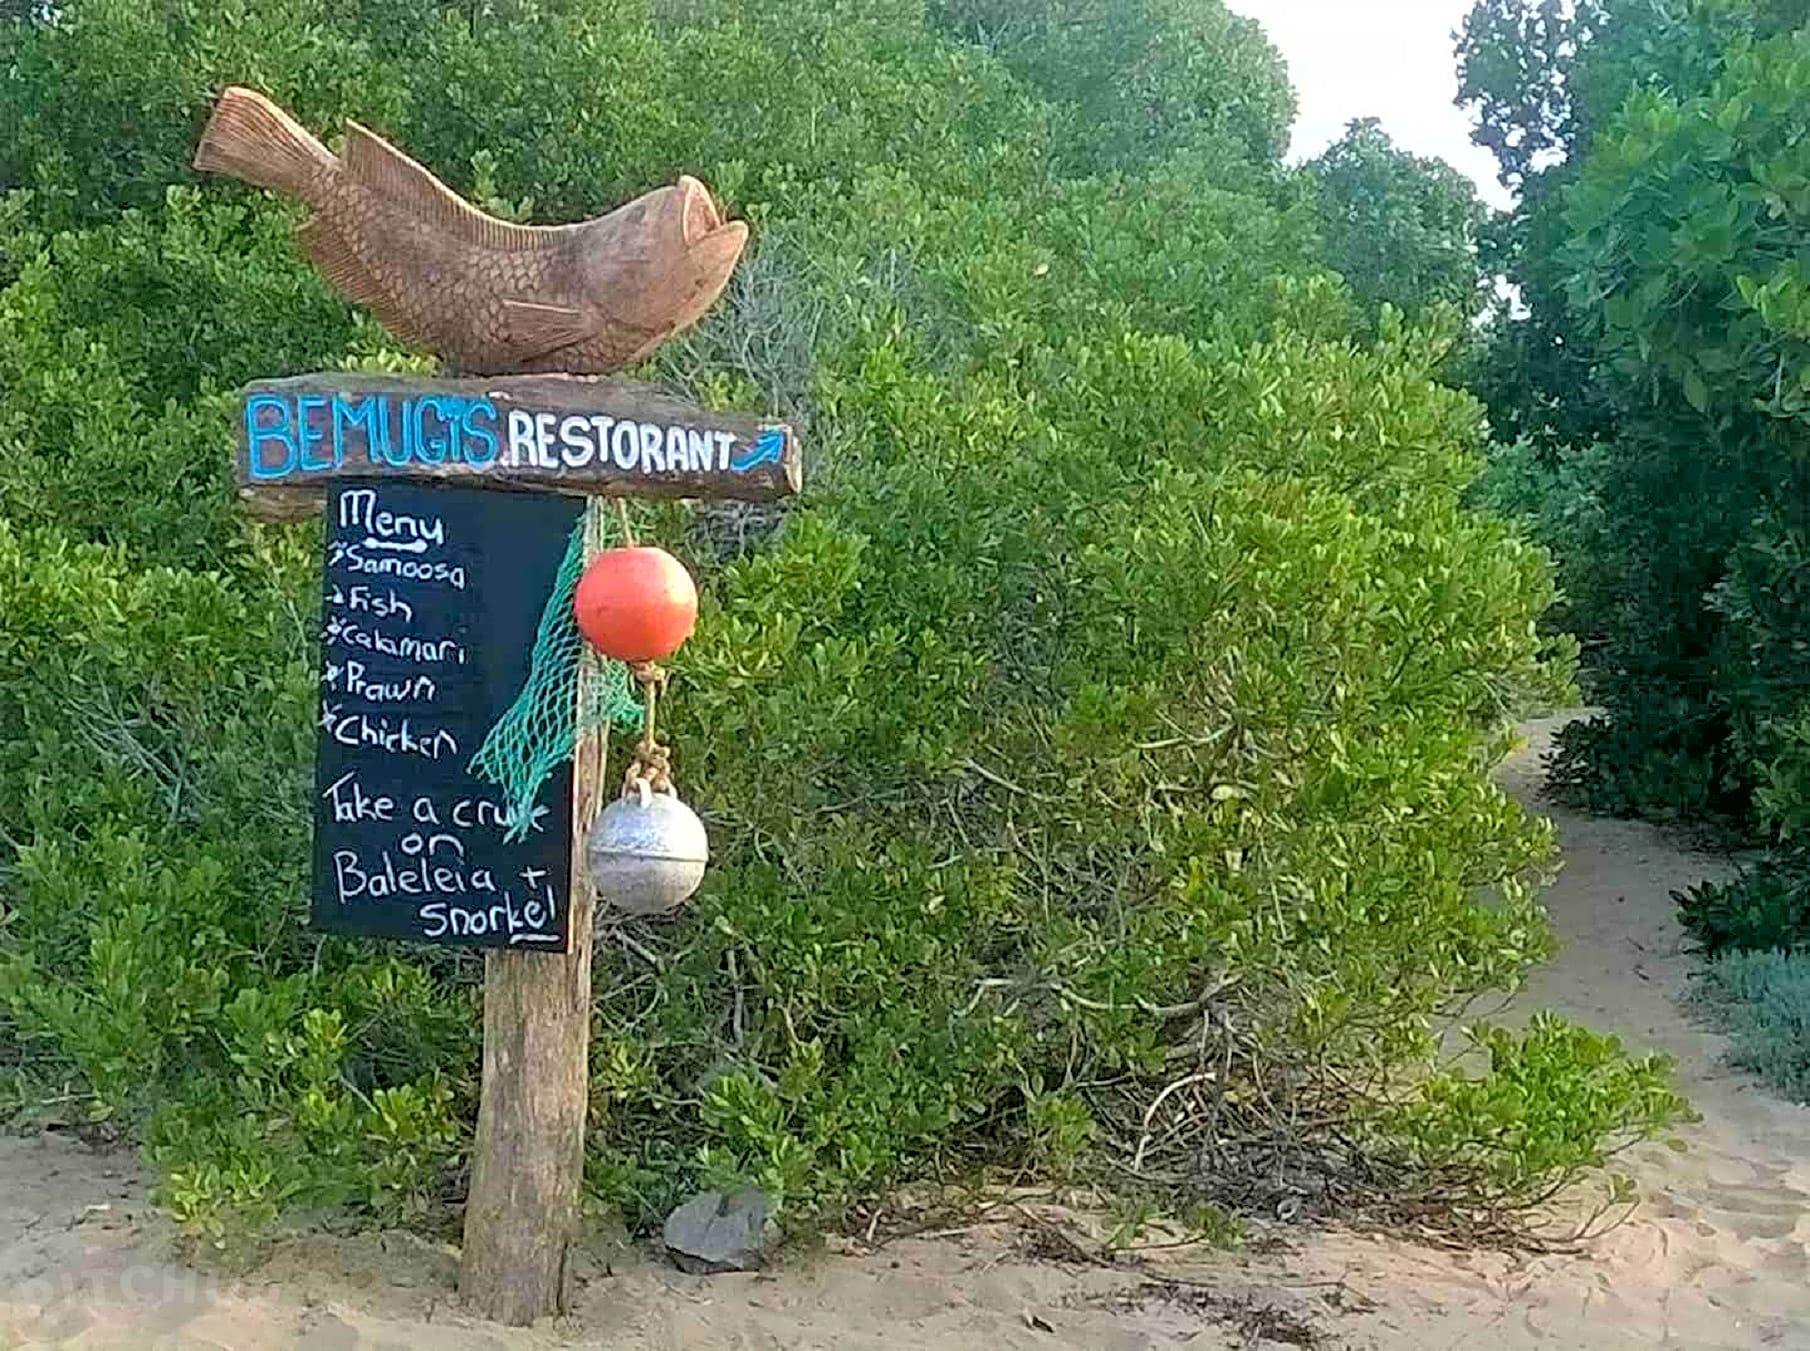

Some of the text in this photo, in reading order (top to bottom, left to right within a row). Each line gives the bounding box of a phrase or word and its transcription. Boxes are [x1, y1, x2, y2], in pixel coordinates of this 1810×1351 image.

[350, 586, 413, 622] Fish
[347, 660, 435, 703] Prawn
[335, 715, 457, 760] Chicken
[322, 770, 395, 822] Take
[412, 797, 440, 825] a
[401, 832, 464, 865] on
